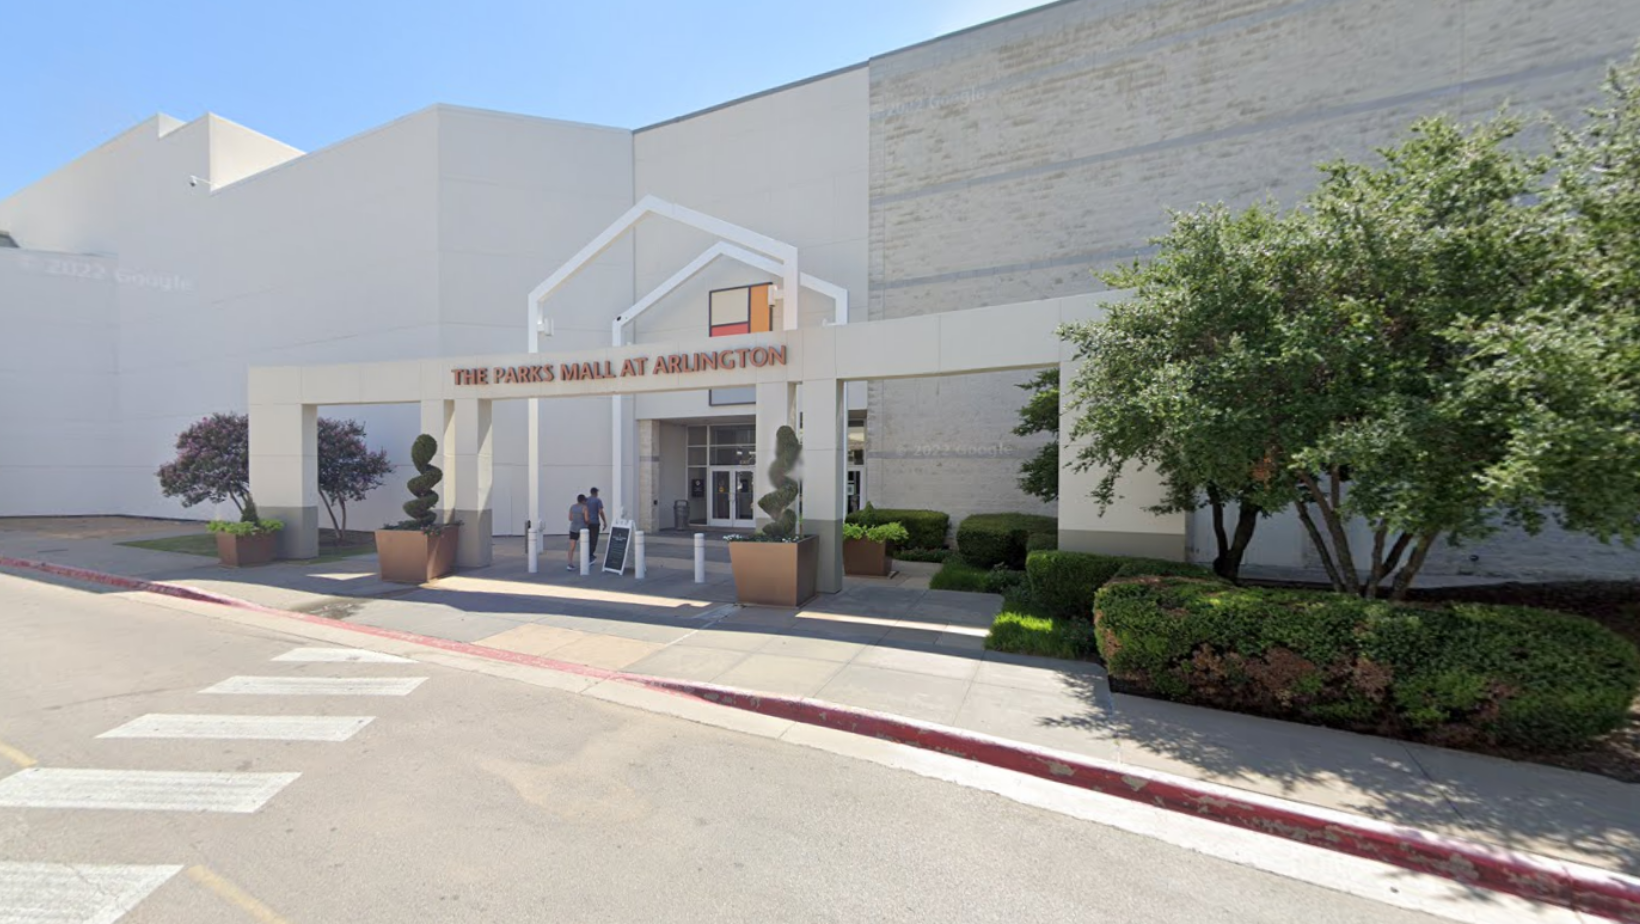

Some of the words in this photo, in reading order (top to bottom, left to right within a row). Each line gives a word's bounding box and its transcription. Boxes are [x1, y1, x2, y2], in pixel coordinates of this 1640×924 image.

[451, 367, 488, 386] THE
[493, 364, 555, 384] PARKS
[560, 361, 616, 381] MALL
[620, 357, 648, 377] AT
[652, 345, 787, 375] ARLINGTON
